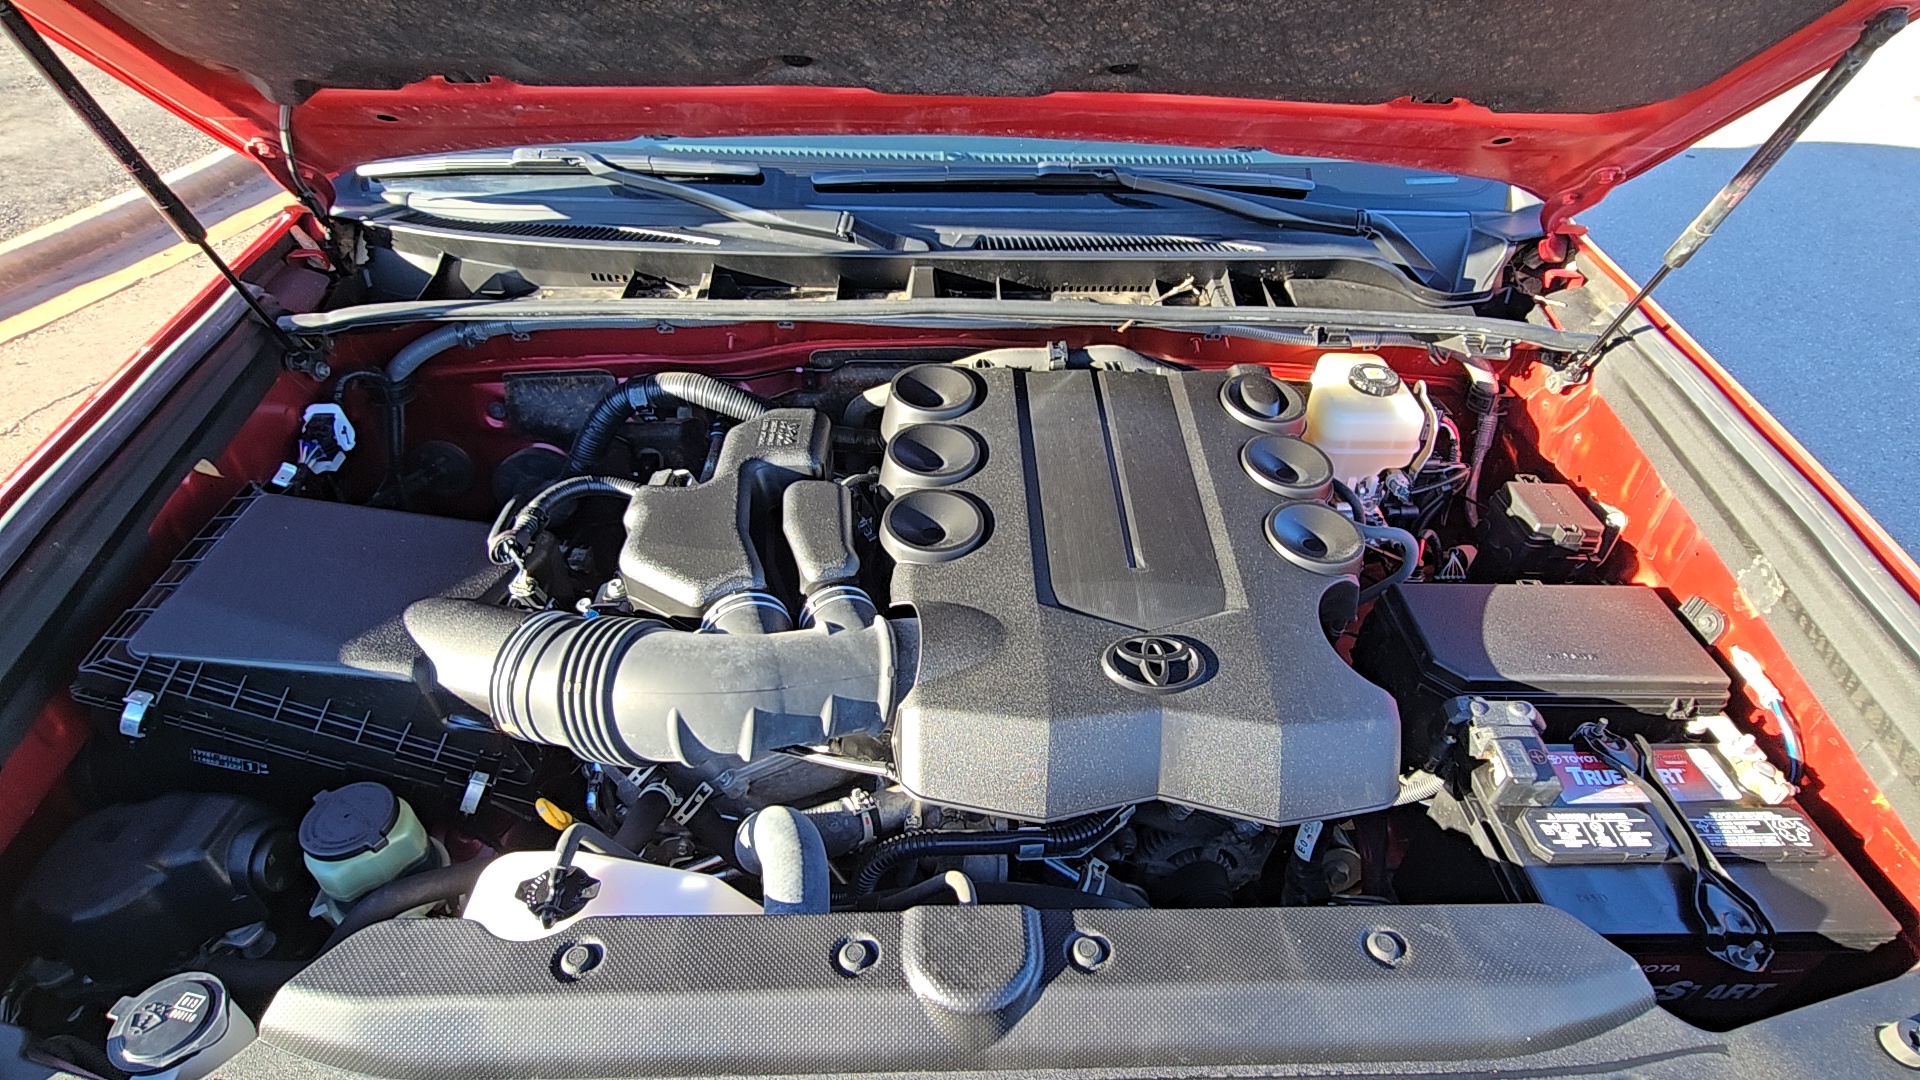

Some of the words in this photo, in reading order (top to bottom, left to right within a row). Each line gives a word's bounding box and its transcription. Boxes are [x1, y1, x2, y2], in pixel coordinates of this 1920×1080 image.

[1561, 755, 1603, 764] TOYOT
[1565, 766, 1685, 785] TRUERT
[1641, 964, 1681, 973] OTA
